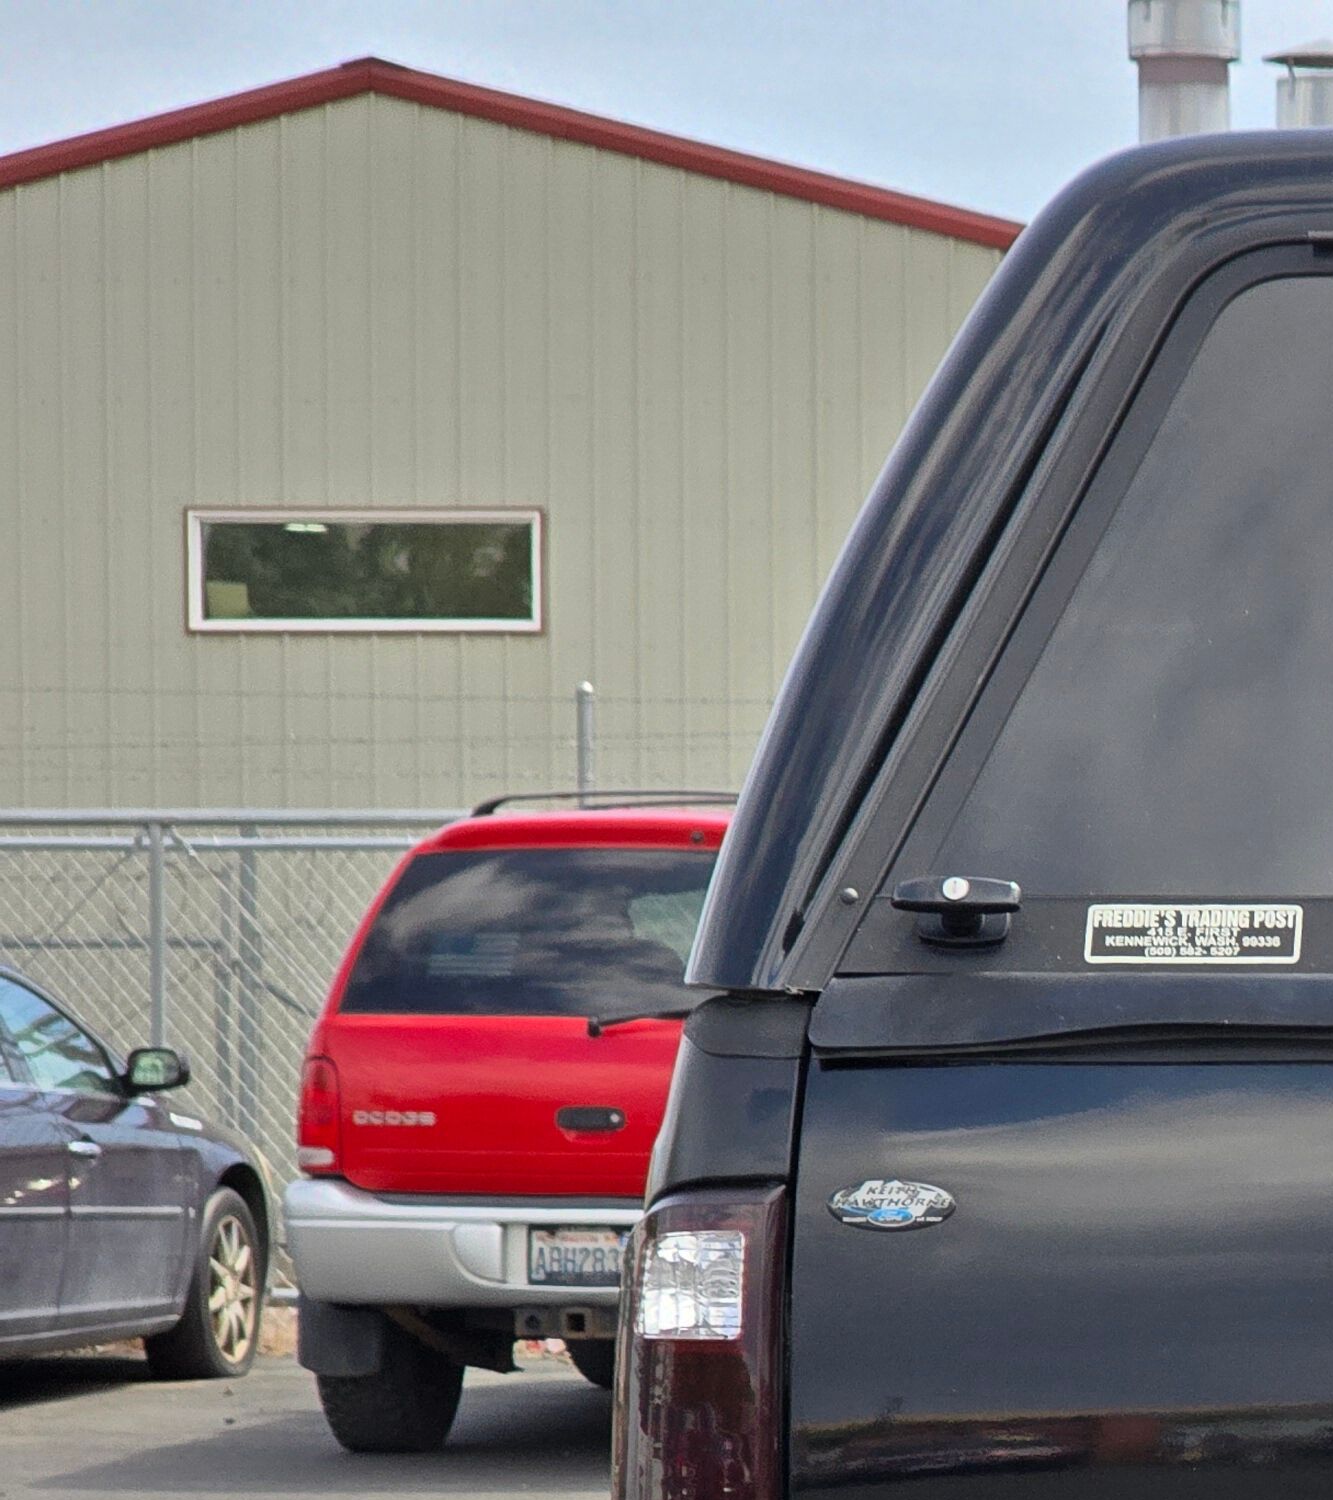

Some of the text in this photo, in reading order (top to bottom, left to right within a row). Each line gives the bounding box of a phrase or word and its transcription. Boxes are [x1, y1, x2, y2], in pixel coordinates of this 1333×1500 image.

[1094, 909, 1296, 930] FREDDIE'S TRADING POST
[1195, 927, 1241, 937] FIRST
[1105, 935, 1192, 948] KENNEWICK,
